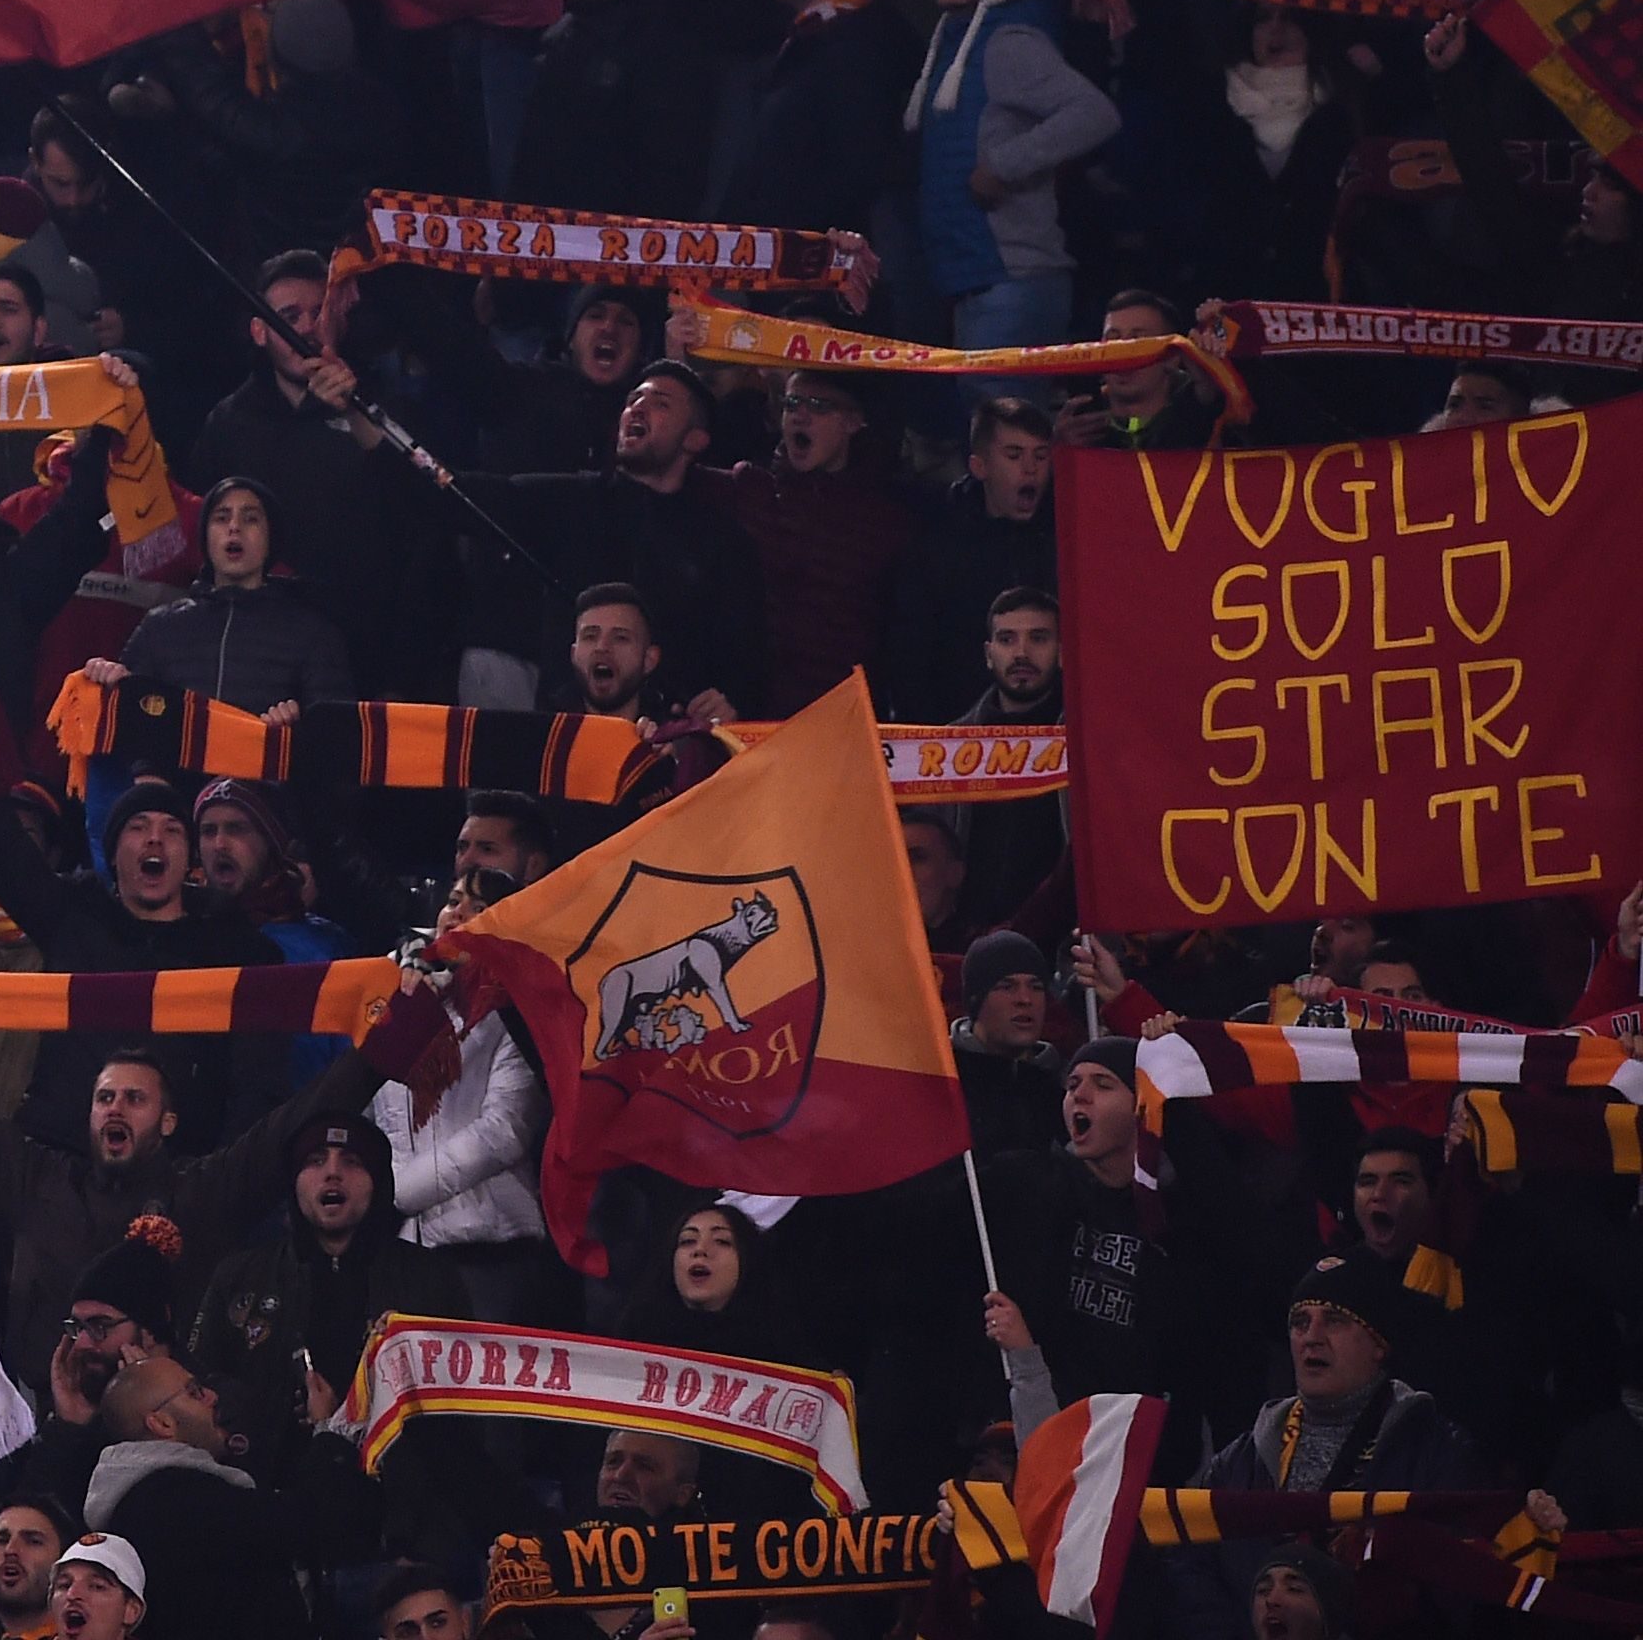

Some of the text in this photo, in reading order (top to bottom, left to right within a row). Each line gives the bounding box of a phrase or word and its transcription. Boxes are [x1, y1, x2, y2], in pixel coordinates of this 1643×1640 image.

[394, 213, 557, 259] FORZA
[599, 226, 759, 267] ROMA
[1256, 307, 1643, 362] BABY SUPPORTER
[1137, 412, 1589, 552] VOGLIO
[1209, 539, 1512, 662] SOLO
[917, 738, 1067, 779] ROMA
[1200, 658, 1531, 788] STAR
[1160, 774, 1601, 916] CON TE
[417, 1339, 779, 1430] FORZA ROMA
[673, 1522, 738, 1582] TE
